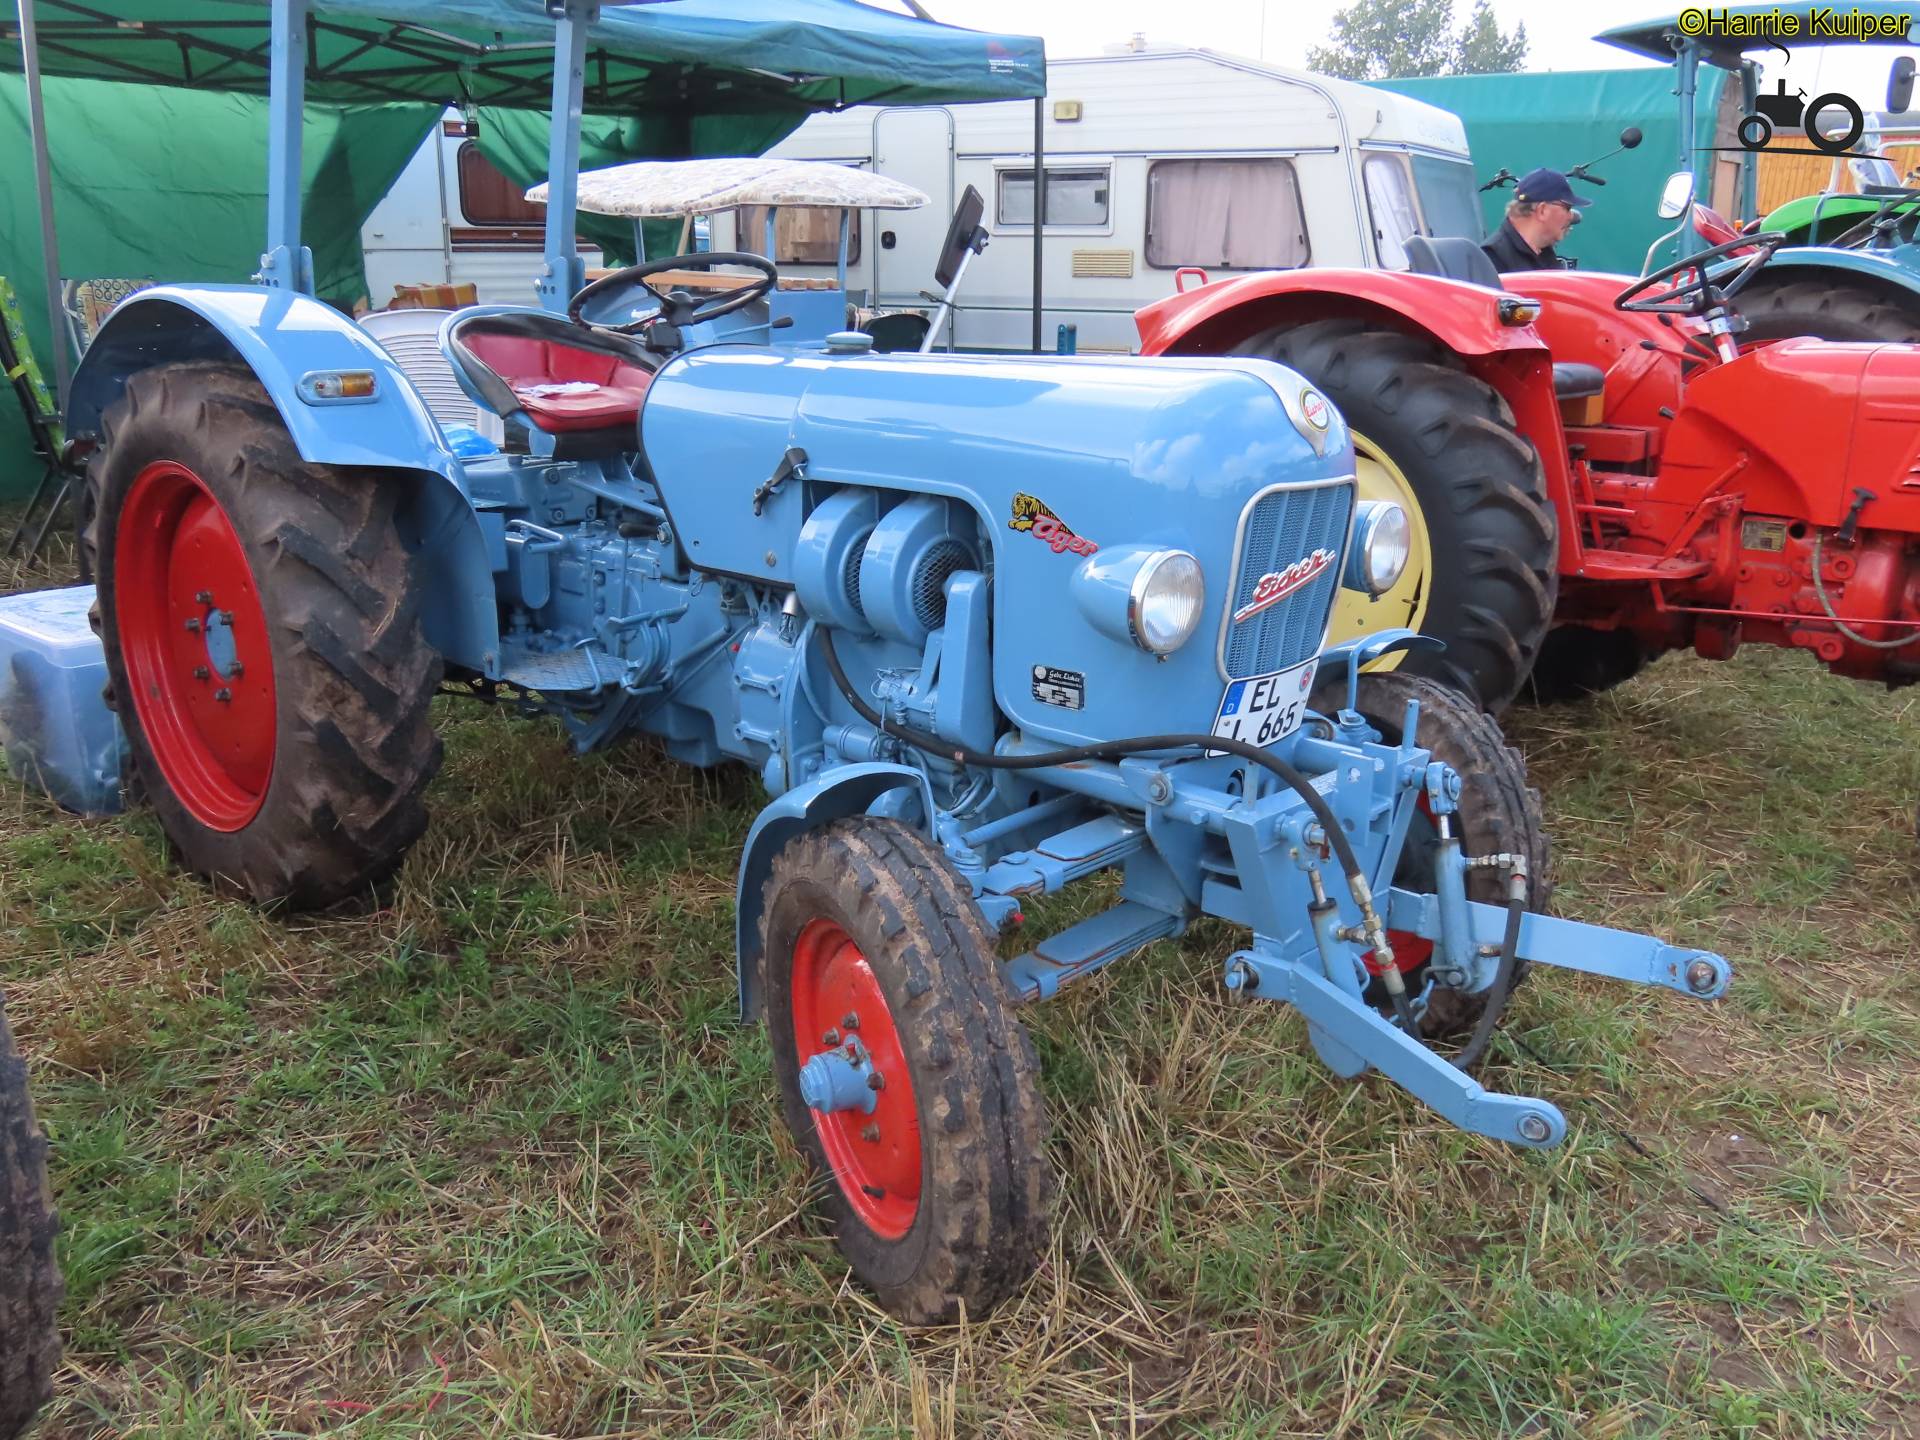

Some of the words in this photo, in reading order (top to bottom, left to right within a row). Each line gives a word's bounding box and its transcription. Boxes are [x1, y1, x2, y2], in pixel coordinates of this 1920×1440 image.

[1033, 513, 1098, 556] Tiger
[1250, 548, 1335, 606] Eicher
[1226, 703, 1234, 713] D
[1249, 678, 1280, 713] EL
[1257, 701, 1298, 743] 665
